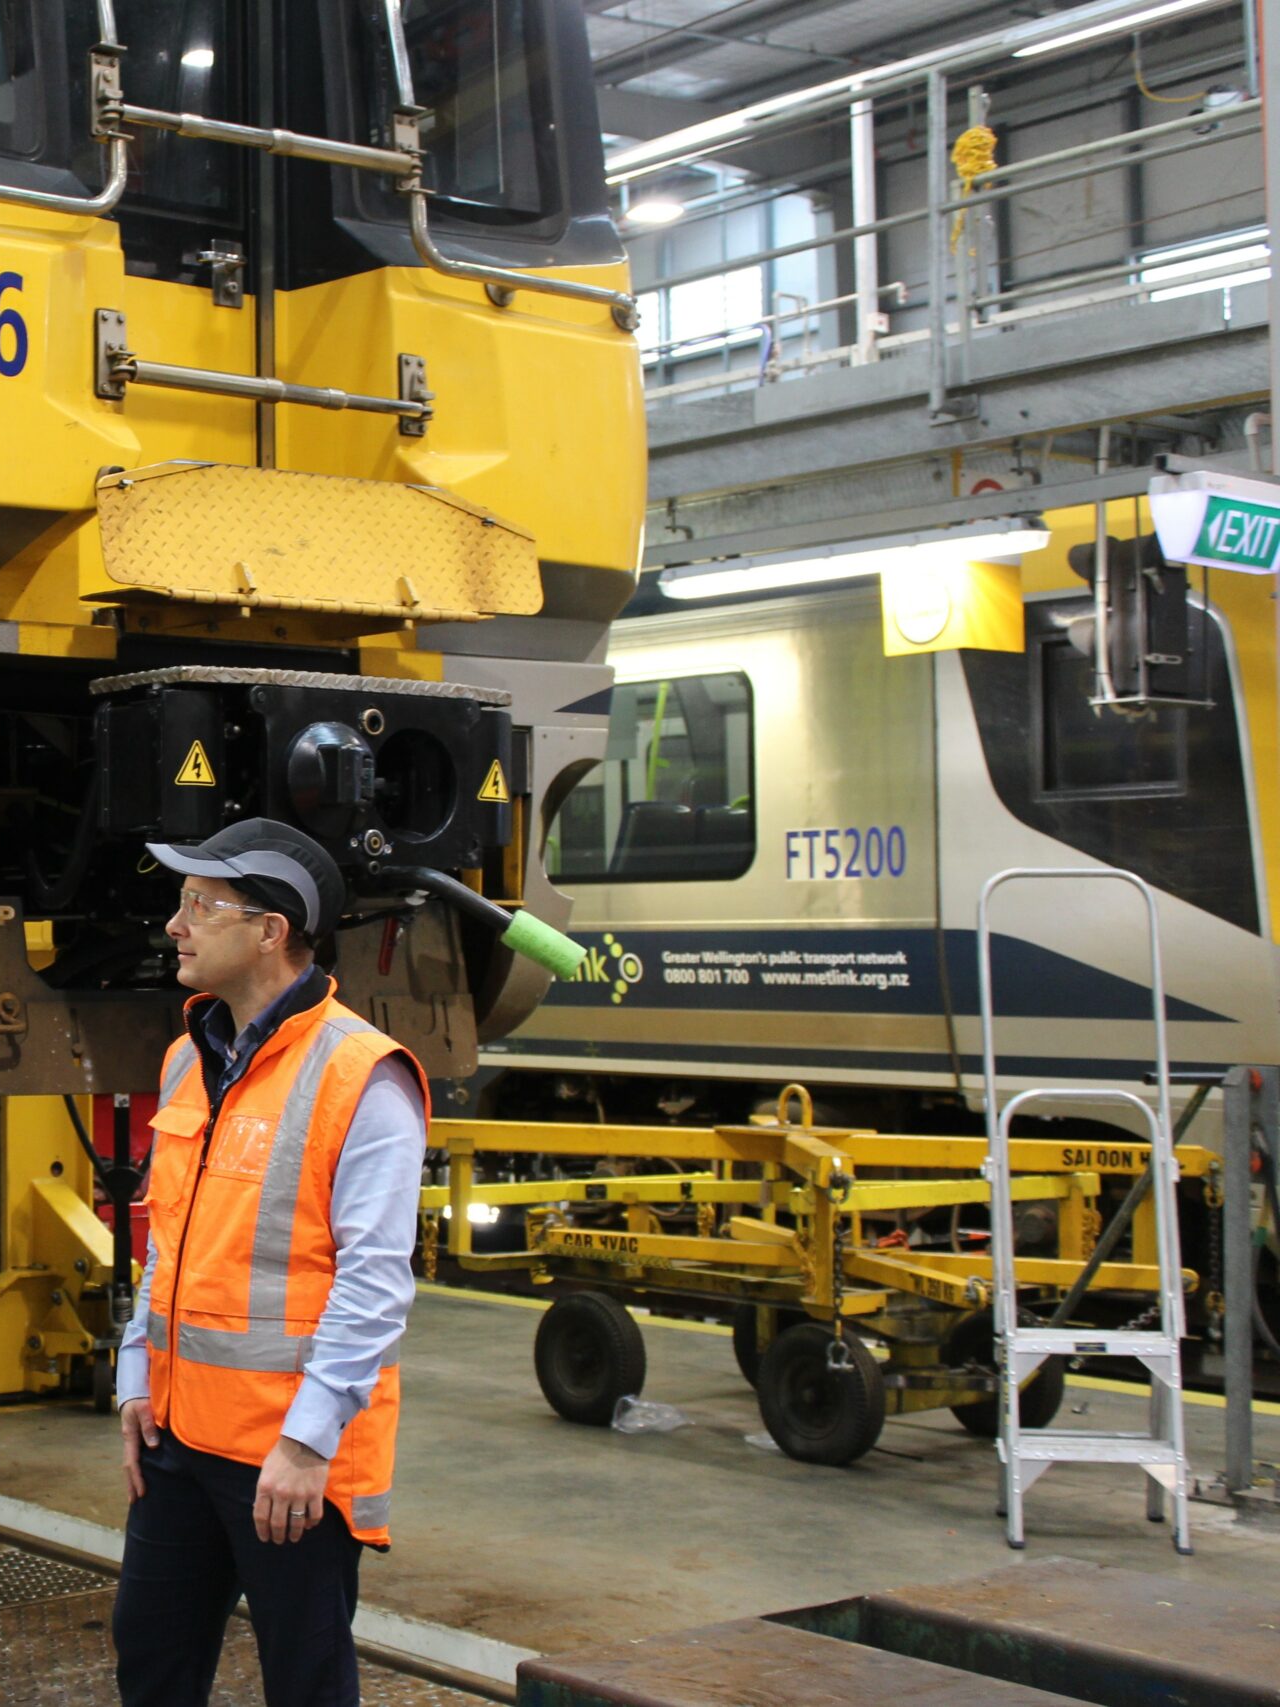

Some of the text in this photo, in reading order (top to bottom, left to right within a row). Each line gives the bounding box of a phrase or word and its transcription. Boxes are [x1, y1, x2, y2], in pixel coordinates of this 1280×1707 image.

[1215, 509, 1280, 559] EXIT
[786, 825, 907, 879] FT5200
[661, 950, 907, 967] Greater Wellington's public transport network
[663, 968, 910, 990] 0800 801 700 www.metlink.org.nz
